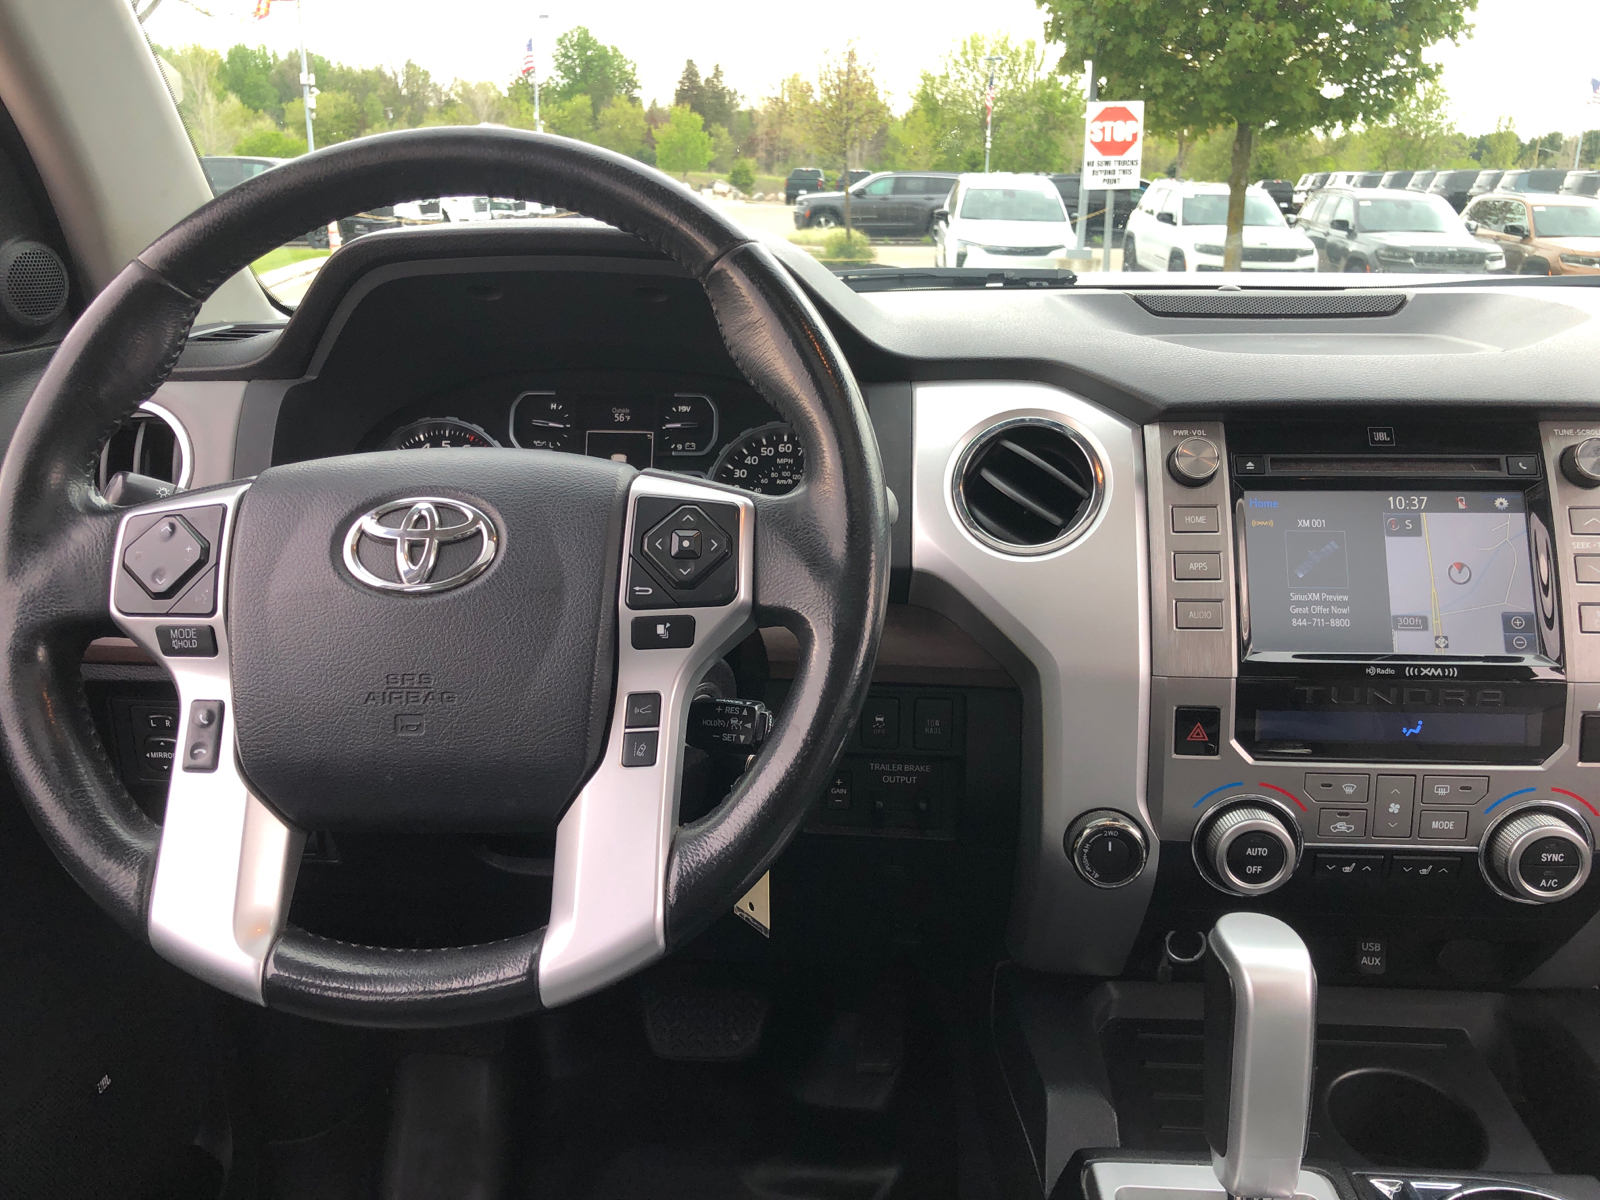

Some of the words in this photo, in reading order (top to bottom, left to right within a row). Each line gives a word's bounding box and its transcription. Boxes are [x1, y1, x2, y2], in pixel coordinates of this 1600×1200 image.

[1090, 120, 1139, 142] STOP
[1114, 159, 1139, 167] TRUCKS
[678, 405, 692, 413] 19V
[1373, 431, 1391, 441] JBL
[760, 447, 775, 457] 50
[778, 443, 793, 453] 60
[744, 456, 759, 465] 40
[733, 469, 747, 478] 30
[1249, 498, 1279, 508] Home
[1387, 496, 1428, 510] 10:37
[1184, 515, 1207, 524] HOME
[1297, 519, 1310, 528] XM
[1311, 519, 1326, 528] 001
[1405, 520, 1413, 530] S
[1188, 562, 1208, 571] APPS
[1290, 592, 1320, 602] SiriusXM
[1321, 593, 1349, 602] Preview
[1188, 611, 1212, 619] AUDIO
[1290, 605, 1310, 615] Great
[1311, 605, 1330, 614] Offer
[1331, 605, 1350, 614] Now!
[1291, 618, 1350, 627] 844-711-8800
[170, 628, 198, 640] MODE
[177, 639, 198, 648] HOLD
[1376, 667, 1396, 675] Radio
[363, 691, 457, 705] AIRBAG
[1295, 685, 1506, 706] TUNDRA
[724, 706, 740, 715] RES
[702, 718, 718, 727] HOLD
[722, 732, 737, 742] SET
[869, 762, 903, 772] TRAILER
[903, 763, 932, 773] BRAKE
[882, 775, 918, 784] OUTPUT
[830, 787, 847, 795] GAIN
[1431, 820, 1455, 830] MODE
[1245, 847, 1268, 857] AUTO
[1540, 852, 1565, 863] SYNC
[1245, 865, 1263, 874] OFF
[1539, 878, 1559, 888] A/C
[1360, 941, 1381, 952] USB
[1360, 956, 1381, 966] AUX
